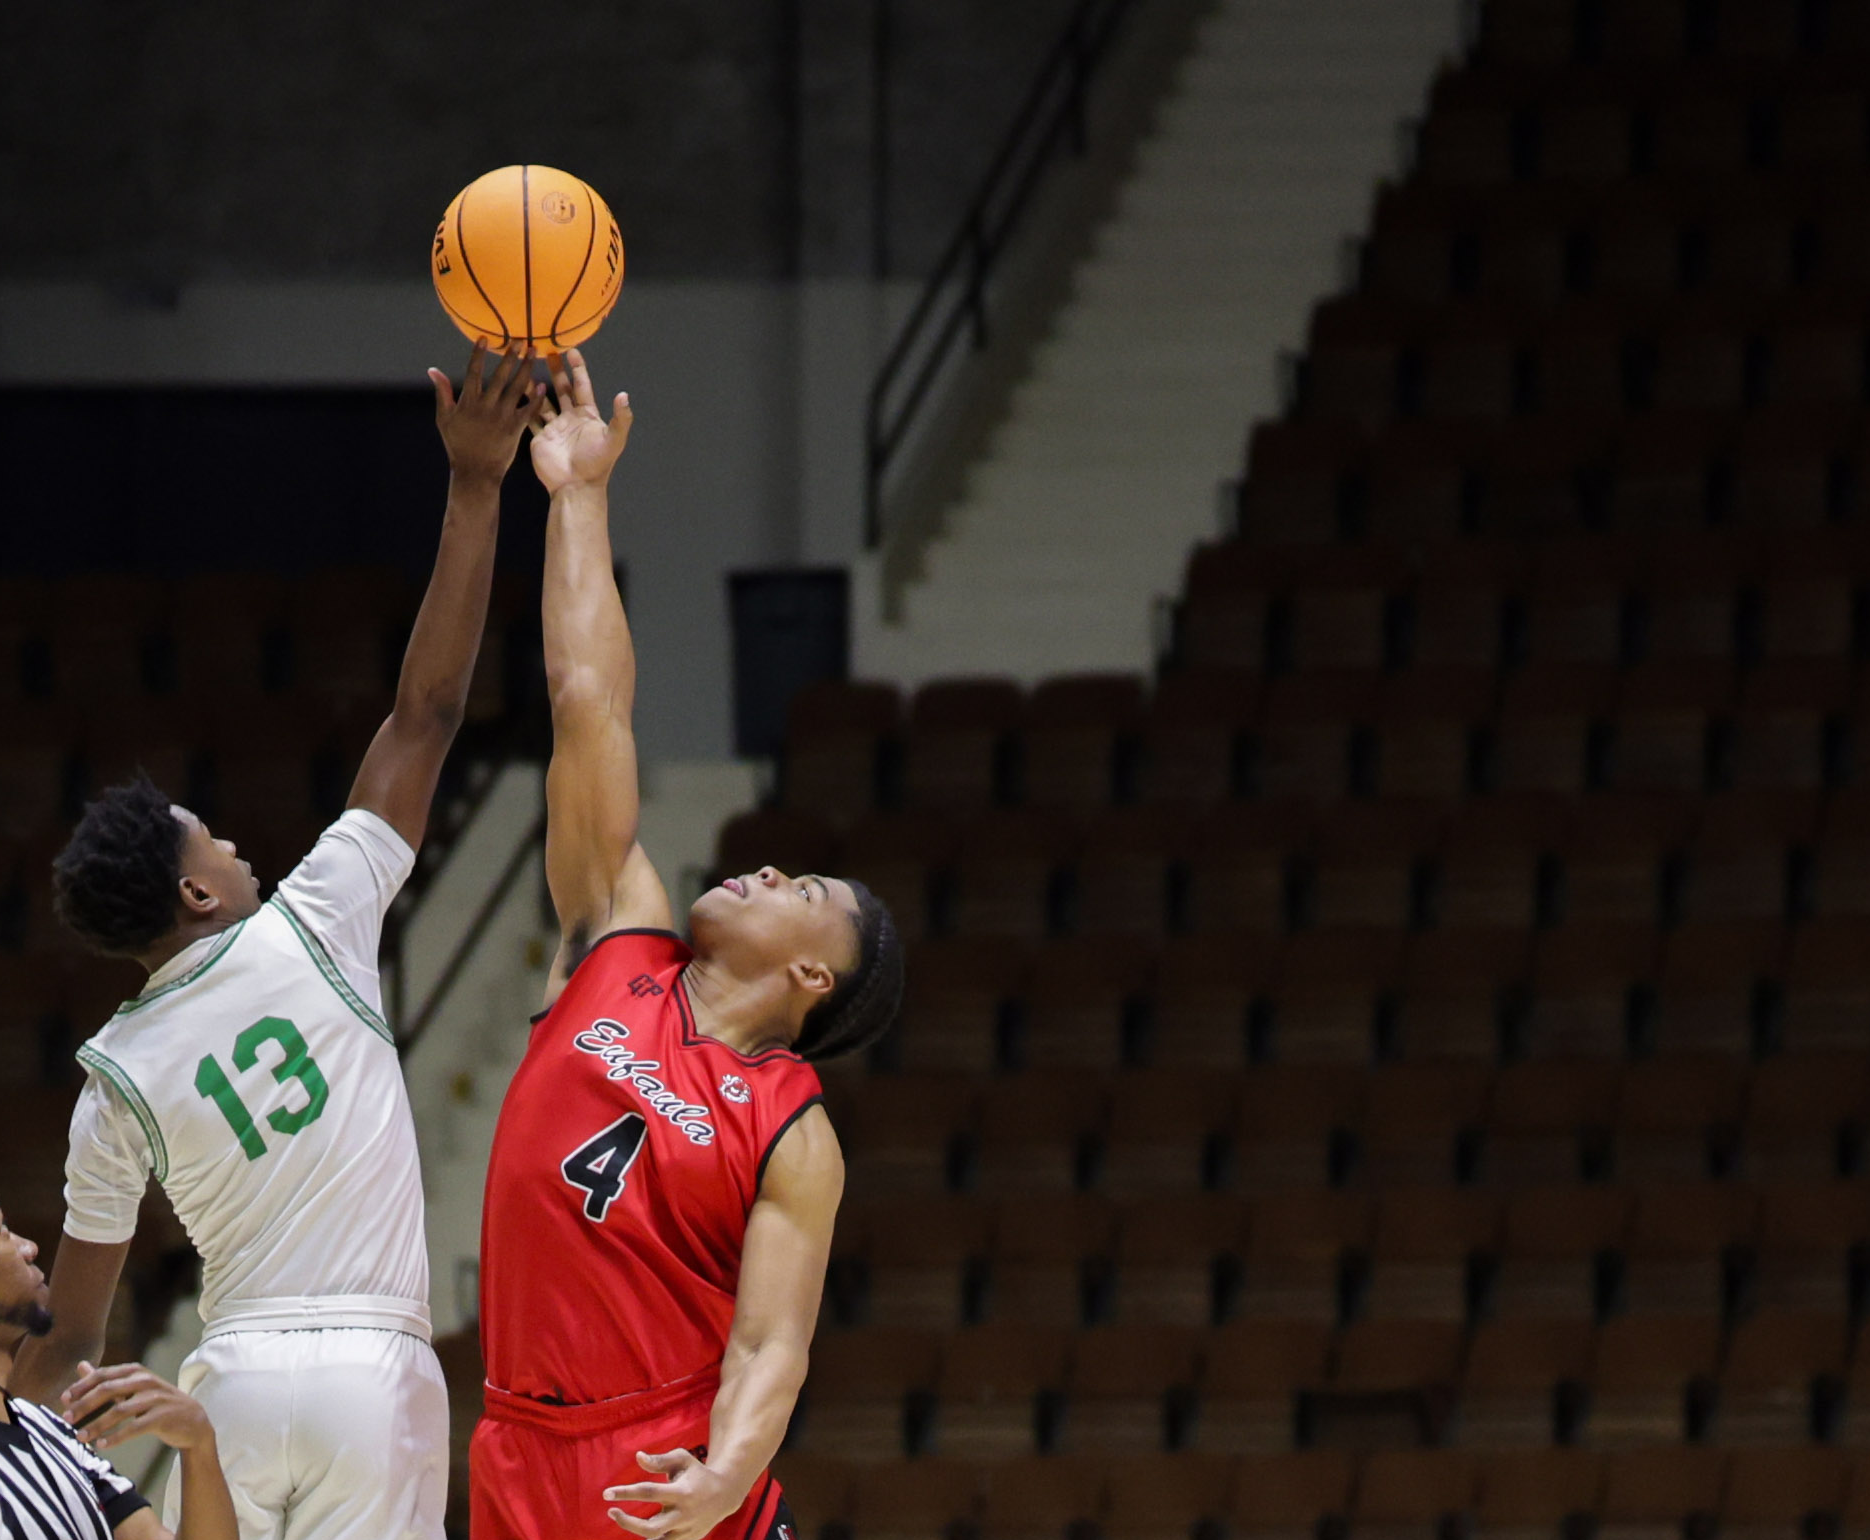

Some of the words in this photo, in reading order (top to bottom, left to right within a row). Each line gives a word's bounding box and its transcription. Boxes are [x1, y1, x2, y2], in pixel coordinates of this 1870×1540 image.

[194, 1015, 329, 1161] 13
[574, 1018, 715, 1146] Eufaula
[561, 1112, 648, 1223] 4
